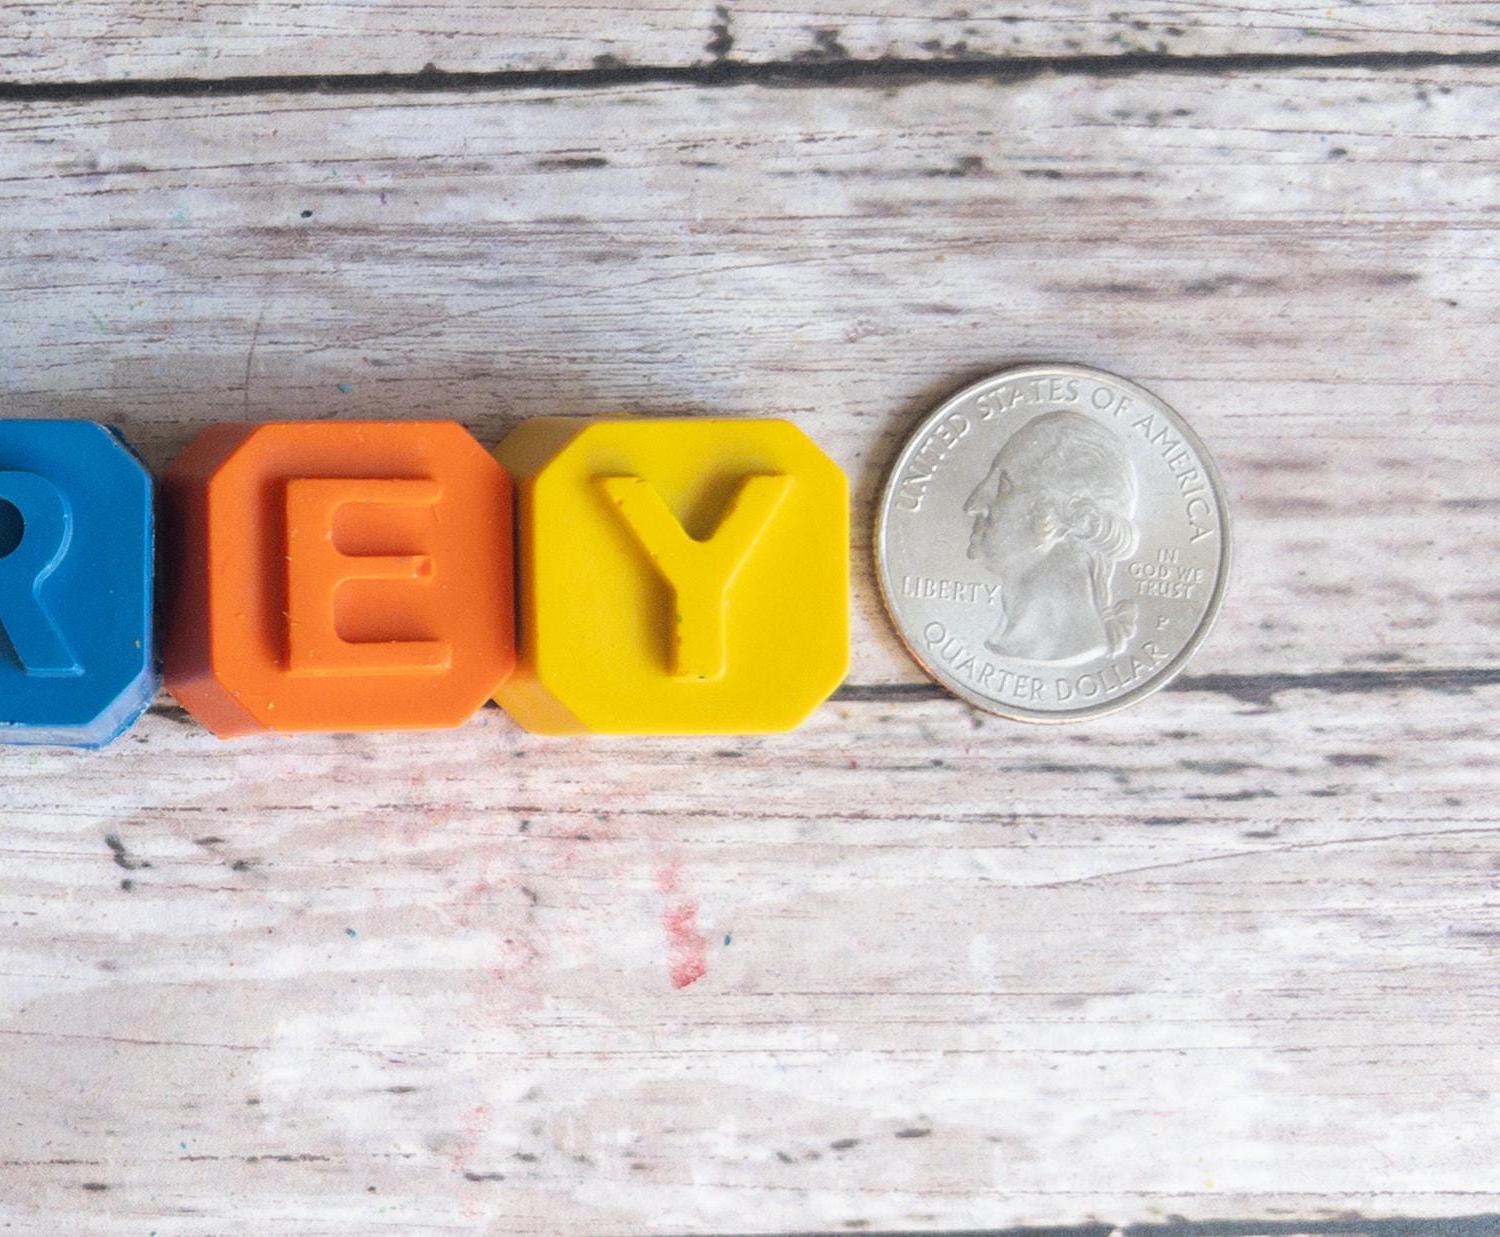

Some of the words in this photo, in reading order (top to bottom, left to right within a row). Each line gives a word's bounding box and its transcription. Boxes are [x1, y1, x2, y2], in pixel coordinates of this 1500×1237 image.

[897, 412, 972, 513] UNITED
[977, 377, 1079, 420] STATES
[1090, 386, 1135, 418] OF
[1131, 413, 1214, 545] AMERICA
[1156, 548, 1180, 565] IN
[1128, 561, 1171, 580] GOD
[1175, 565, 1205, 583] WE
[901, 575, 1000, 606] LIBERTY
[1135, 579, 1195, 600] TRUST
[923, 620, 1045, 701] QUARTER
[1055, 639, 1171, 702] DOLLAR
